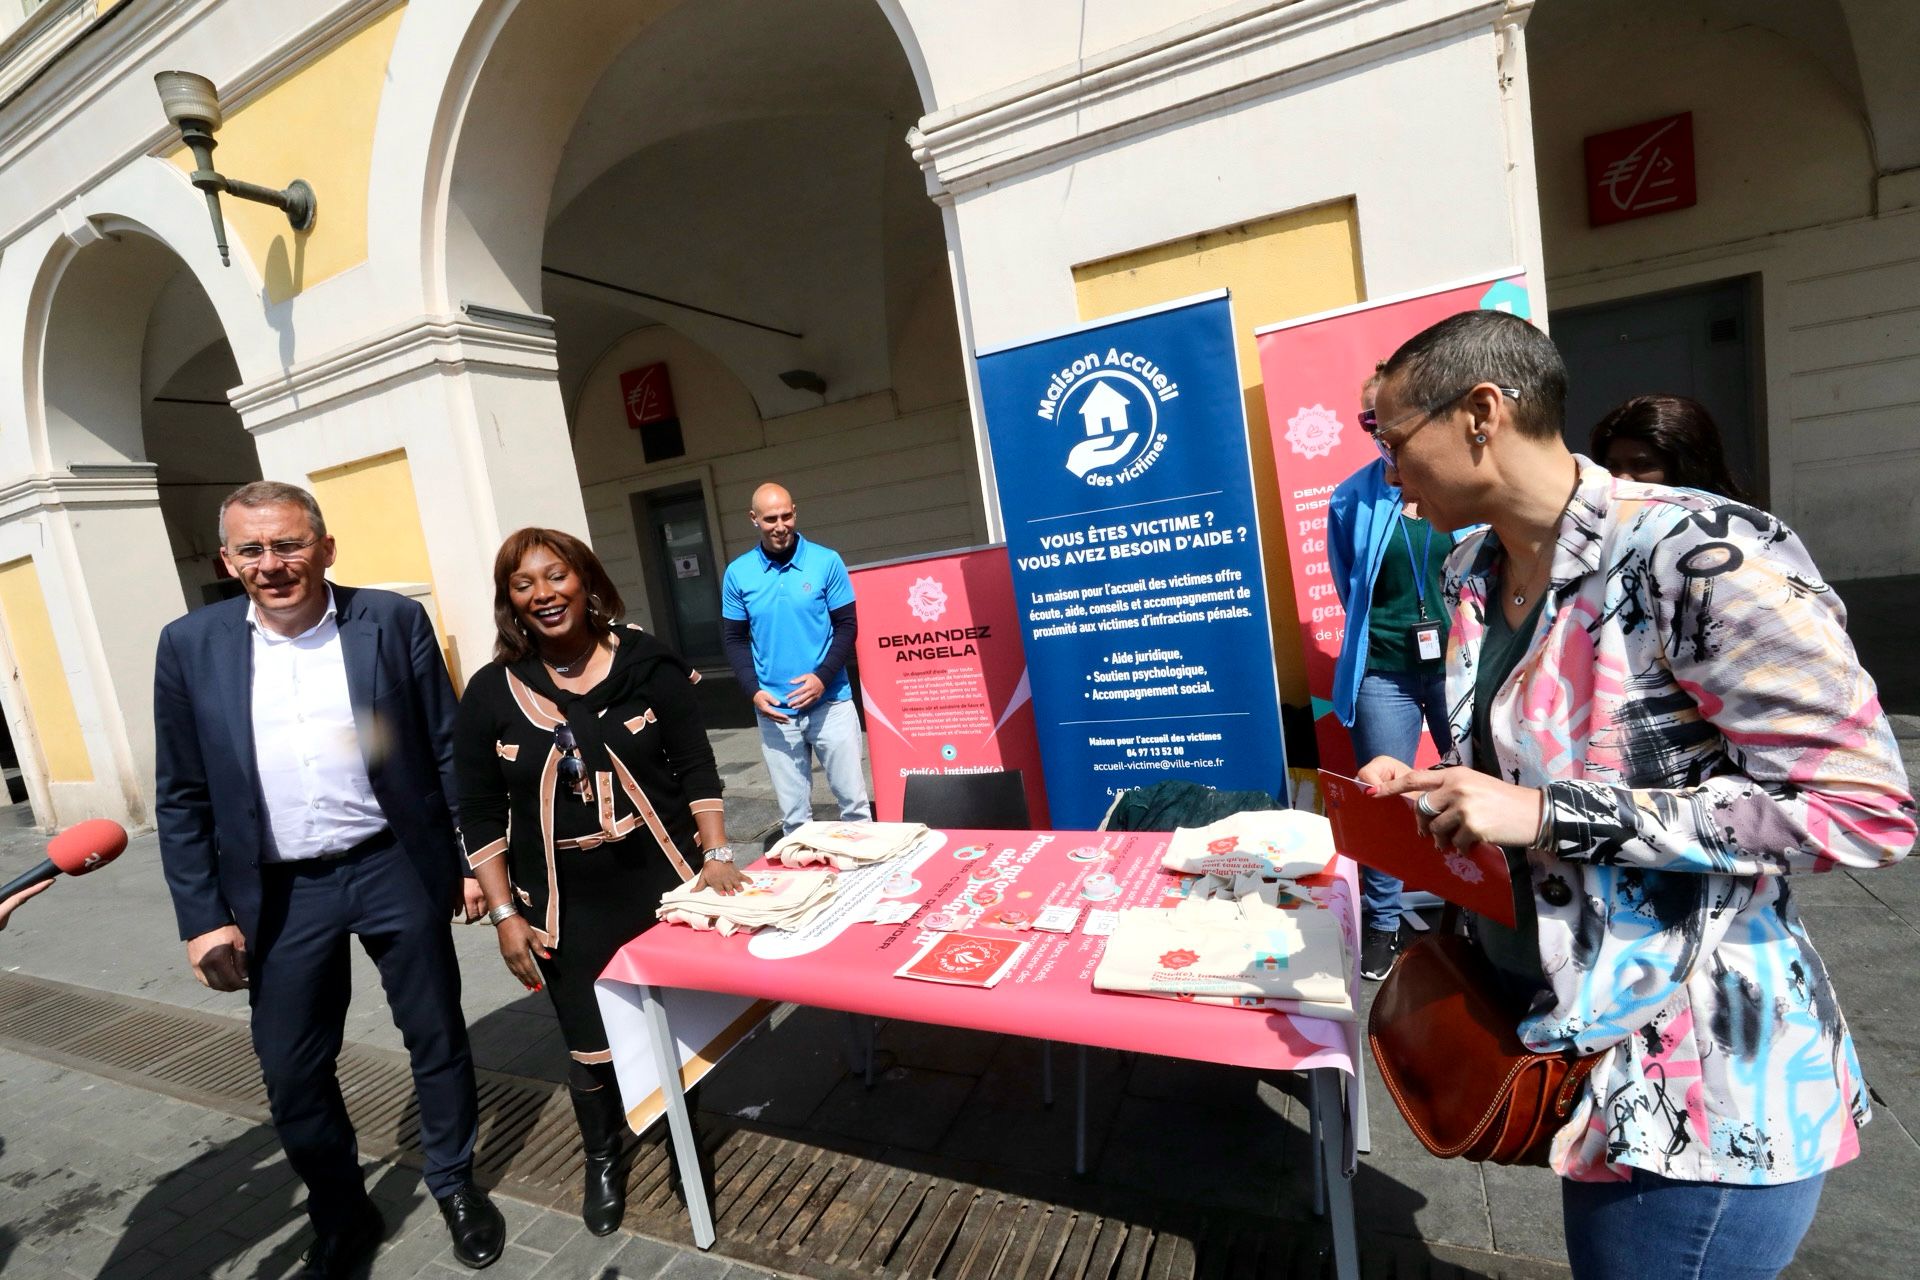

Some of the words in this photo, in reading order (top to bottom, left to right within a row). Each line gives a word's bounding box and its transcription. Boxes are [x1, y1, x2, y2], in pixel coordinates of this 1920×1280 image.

[1038, 352, 1100, 421] Maison
[1104, 347, 1179, 403] Accueil
[1086, 472, 1114, 487] des
[1116, 433, 1168, 485] victimes
[1040, 531, 1085, 550] VOUS
[1088, 525, 1128, 544] ÊTES
[1131, 514, 1201, 537] VICTIME
[1204, 511, 1215, 527] ?
[1017, 552, 1060, 572] VOUS
[1064, 547, 1107, 566] AVEZ
[1110, 539, 1171, 560] BESOIN
[1176, 530, 1234, 549] D'AIDE
[1237, 527, 1247, 542] ?
[1301, 538, 1325, 554] de
[1305, 562, 1329, 576] ou
[1031, 592, 1043, 604] La
[1045, 589, 1080, 602] maison
[1081, 587, 1103, 600] pour
[1104, 579, 1147, 595] l'accueil
[1148, 578, 1167, 590] des
[1168, 573, 1213, 588] victimes
[1215, 569, 1242, 583] offre
[1029, 608, 1064, 621] écoute,
[1065, 604, 1088, 618] aide,
[1089, 600, 1129, 614] conseils
[1131, 598, 1142, 610] et
[1144, 587, 1235, 608] accompagnement
[1236, 586, 1250, 599] de
[1033, 621, 1077, 640] proximité
[1079, 623, 1097, 633] aux
[1098, 618, 1139, 631] victimes
[1141, 611, 1205, 626] d'infractions
[1207, 606, 1252, 623] pénales.
[878, 625, 992, 649] DEMANDEZ
[1315, 629, 1332, 641] de
[895, 644, 977, 663] ANGELA
[1111, 651, 1133, 664] Aide
[1135, 649, 1183, 665] juridique,
[1093, 670, 1130, 683] Soutien
[1132, 664, 1208, 682] psychologique,
[1092, 684, 1179, 701] Accompagnement
[1180, 681, 1214, 695] social.
[1089, 737, 1116, 746] Maison
[1117, 736, 1134, 747] pour
[1136, 734, 1169, 744] l'accueil
[1171, 733, 1185, 743] des
[1186, 732, 1222, 741] victimes
[1126, 748, 1137, 757] 04
[1138, 748, 1148, 757] 97
[1150, 748, 1160, 757] 13
[1162, 747, 1172, 756] 52
[1173, 746, 1184, 755] 00
[1093, 758, 1224, 771] accueil-victime@ville-nice.fr
[1106, 787, 1115, 796] 6,
[1016, 834, 1056, 864] Parce
